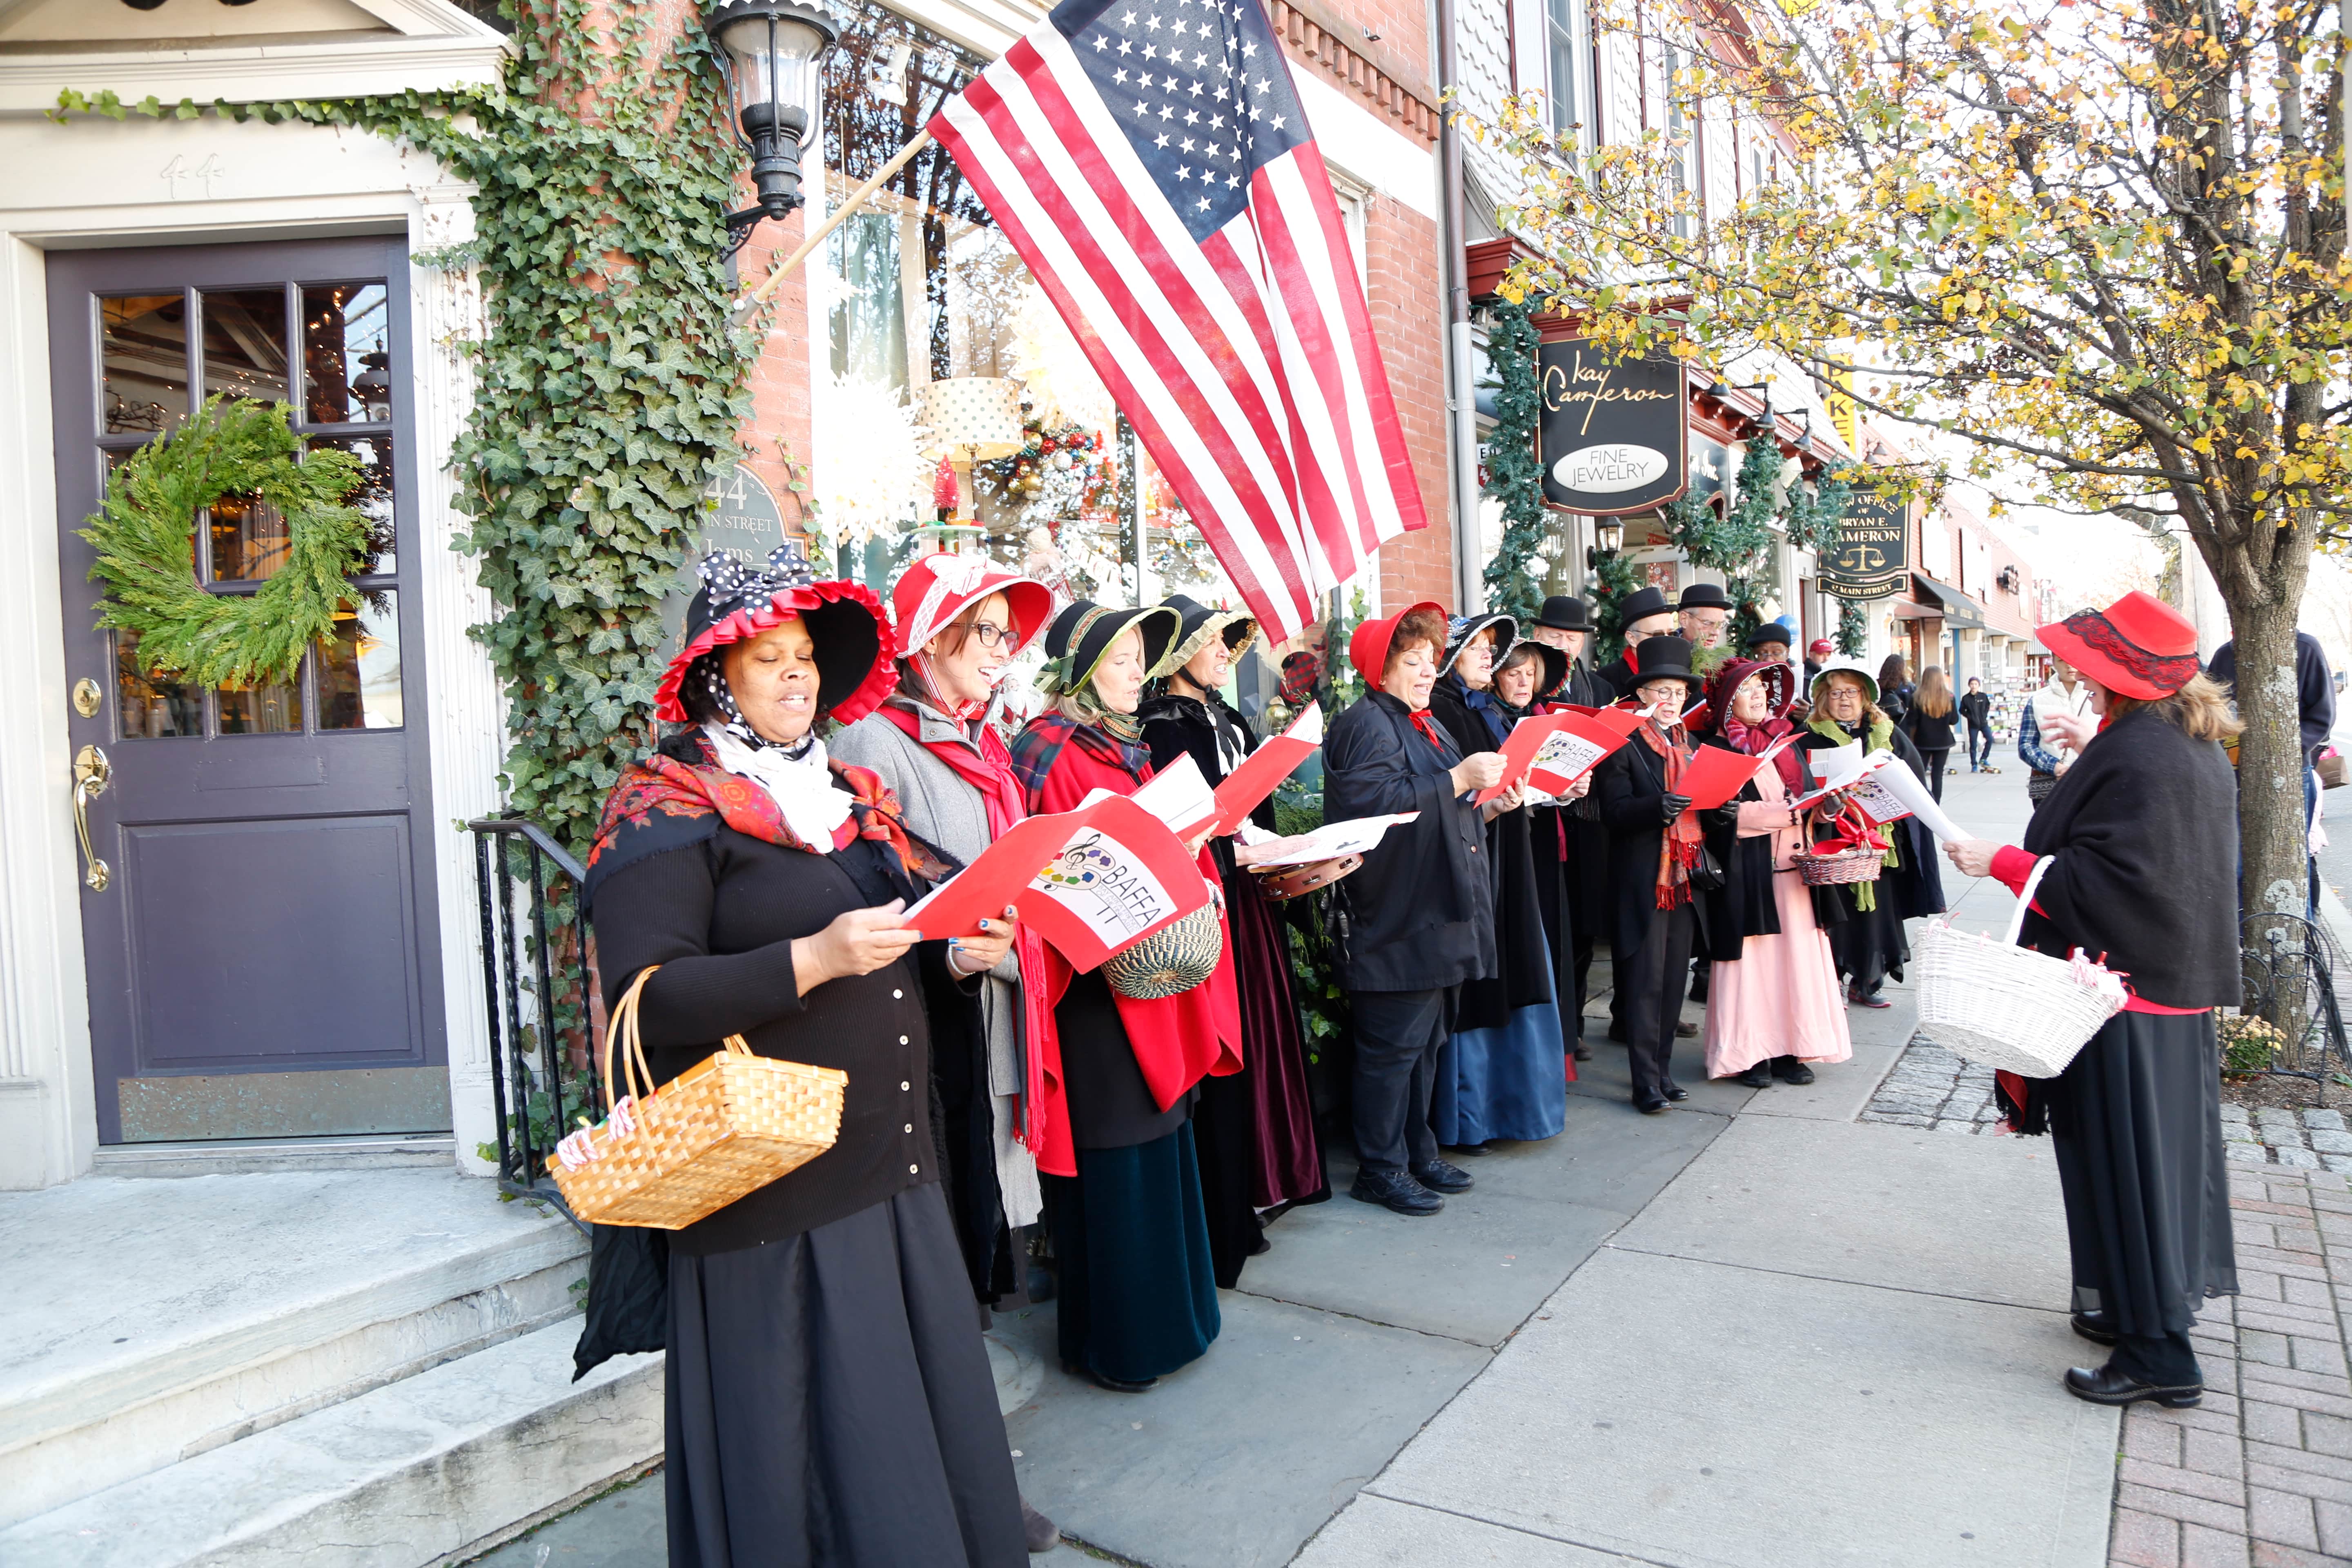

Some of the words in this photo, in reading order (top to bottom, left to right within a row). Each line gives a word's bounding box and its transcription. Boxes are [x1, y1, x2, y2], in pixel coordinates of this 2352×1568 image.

[1544, 364, 1675, 412] Cameron
[1828, 360, 1850, 447] BAKE
[1590, 448, 1629, 465] FINE
[1572, 461, 1649, 487] JEWELRY
[704, 472, 747, 510] 44
[1858, 494, 1899, 515] OFFICE
[725, 515, 773, 532] STREET
[1839, 517, 1875, 527] BRYAN
[1878, 517, 1888, 526] E.
[1839, 530, 1900, 542] AMERON
[1839, 586, 1862, 595] MAIN
[1862, 583, 1892, 595] STREET
[1564, 744, 1597, 765] BAFFA
[1878, 793, 1904, 817] BAFFA
[1098, 885, 1110, 895] BAY
[1109, 895, 1123, 909] AREA
[1122, 909, 1140, 931] FRIENDS
[1102, 865, 1161, 927] BAFFA
[1104, 897, 1114, 906] THE
[1113, 905, 1124, 916] FINE
[1122, 918, 1135, 933] ARTS
